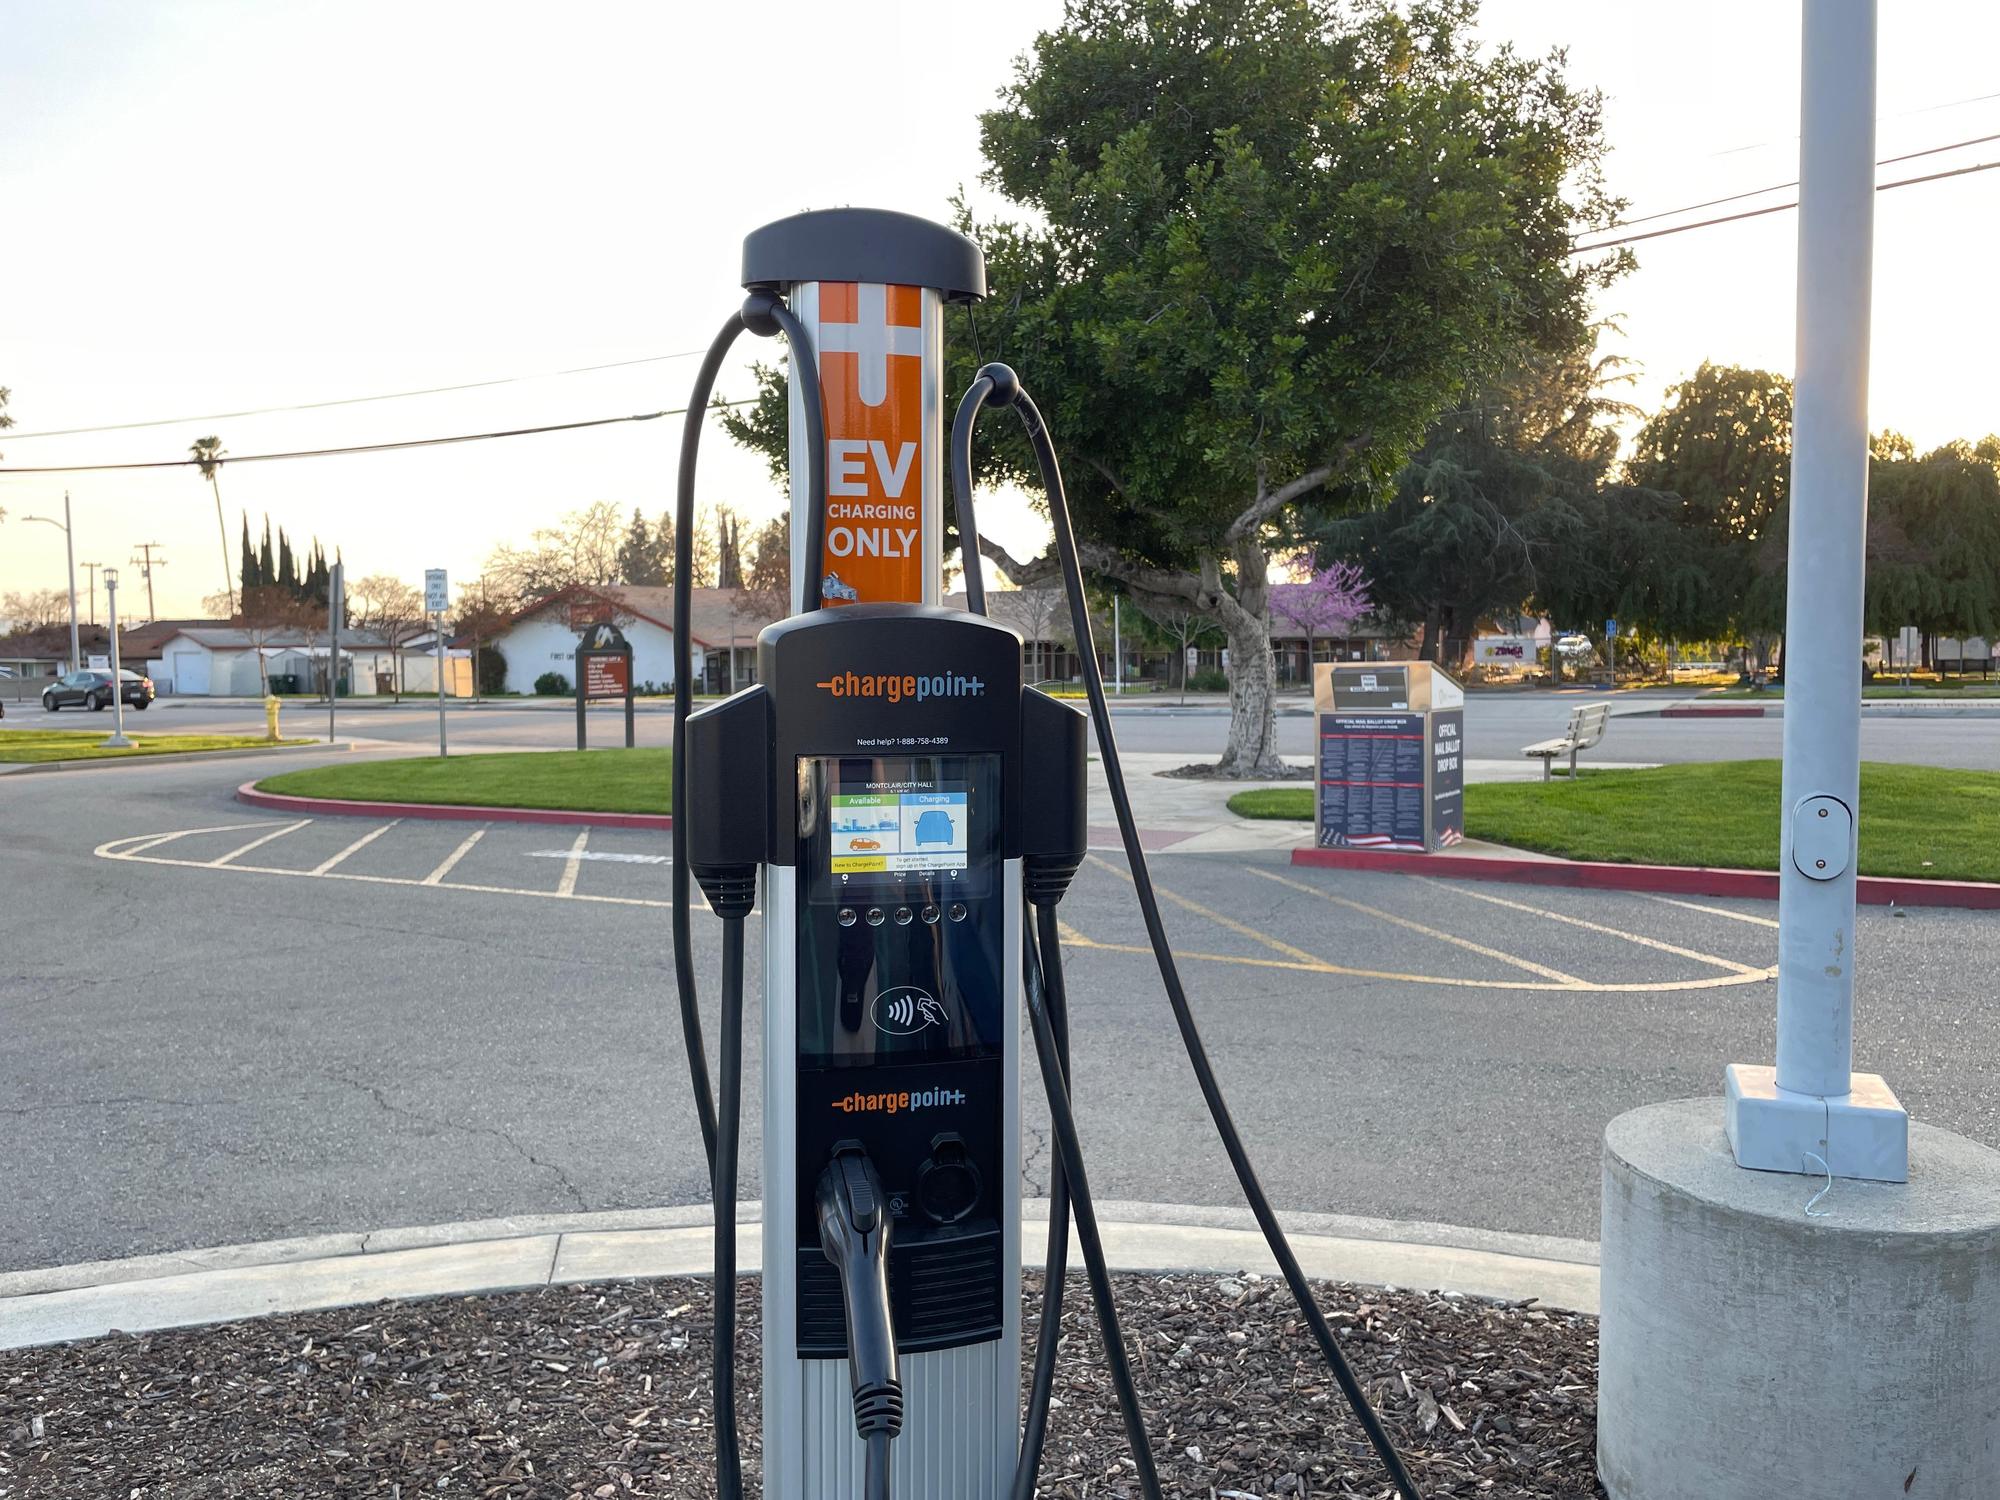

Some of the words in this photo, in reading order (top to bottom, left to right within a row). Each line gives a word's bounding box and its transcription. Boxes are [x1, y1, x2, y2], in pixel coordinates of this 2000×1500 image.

[828, 439, 918, 498] EV
[828, 503, 916, 520] CHARGING
[828, 526, 918, 558] ONLY
[1438, 723, 1457, 738] OFFICIAL
[857, 738, 876, 746] Need
[877, 738, 895, 747] help?
[896, 737, 949, 745] 1-888-758-4389
[1434, 741, 1445, 756] MAIL
[1445, 739, 1460, 754] BALLOT
[1437, 758, 1449, 773] DROP
[1449, 756, 1458, 771] BOX
[919, 795, 950, 804] Charging
